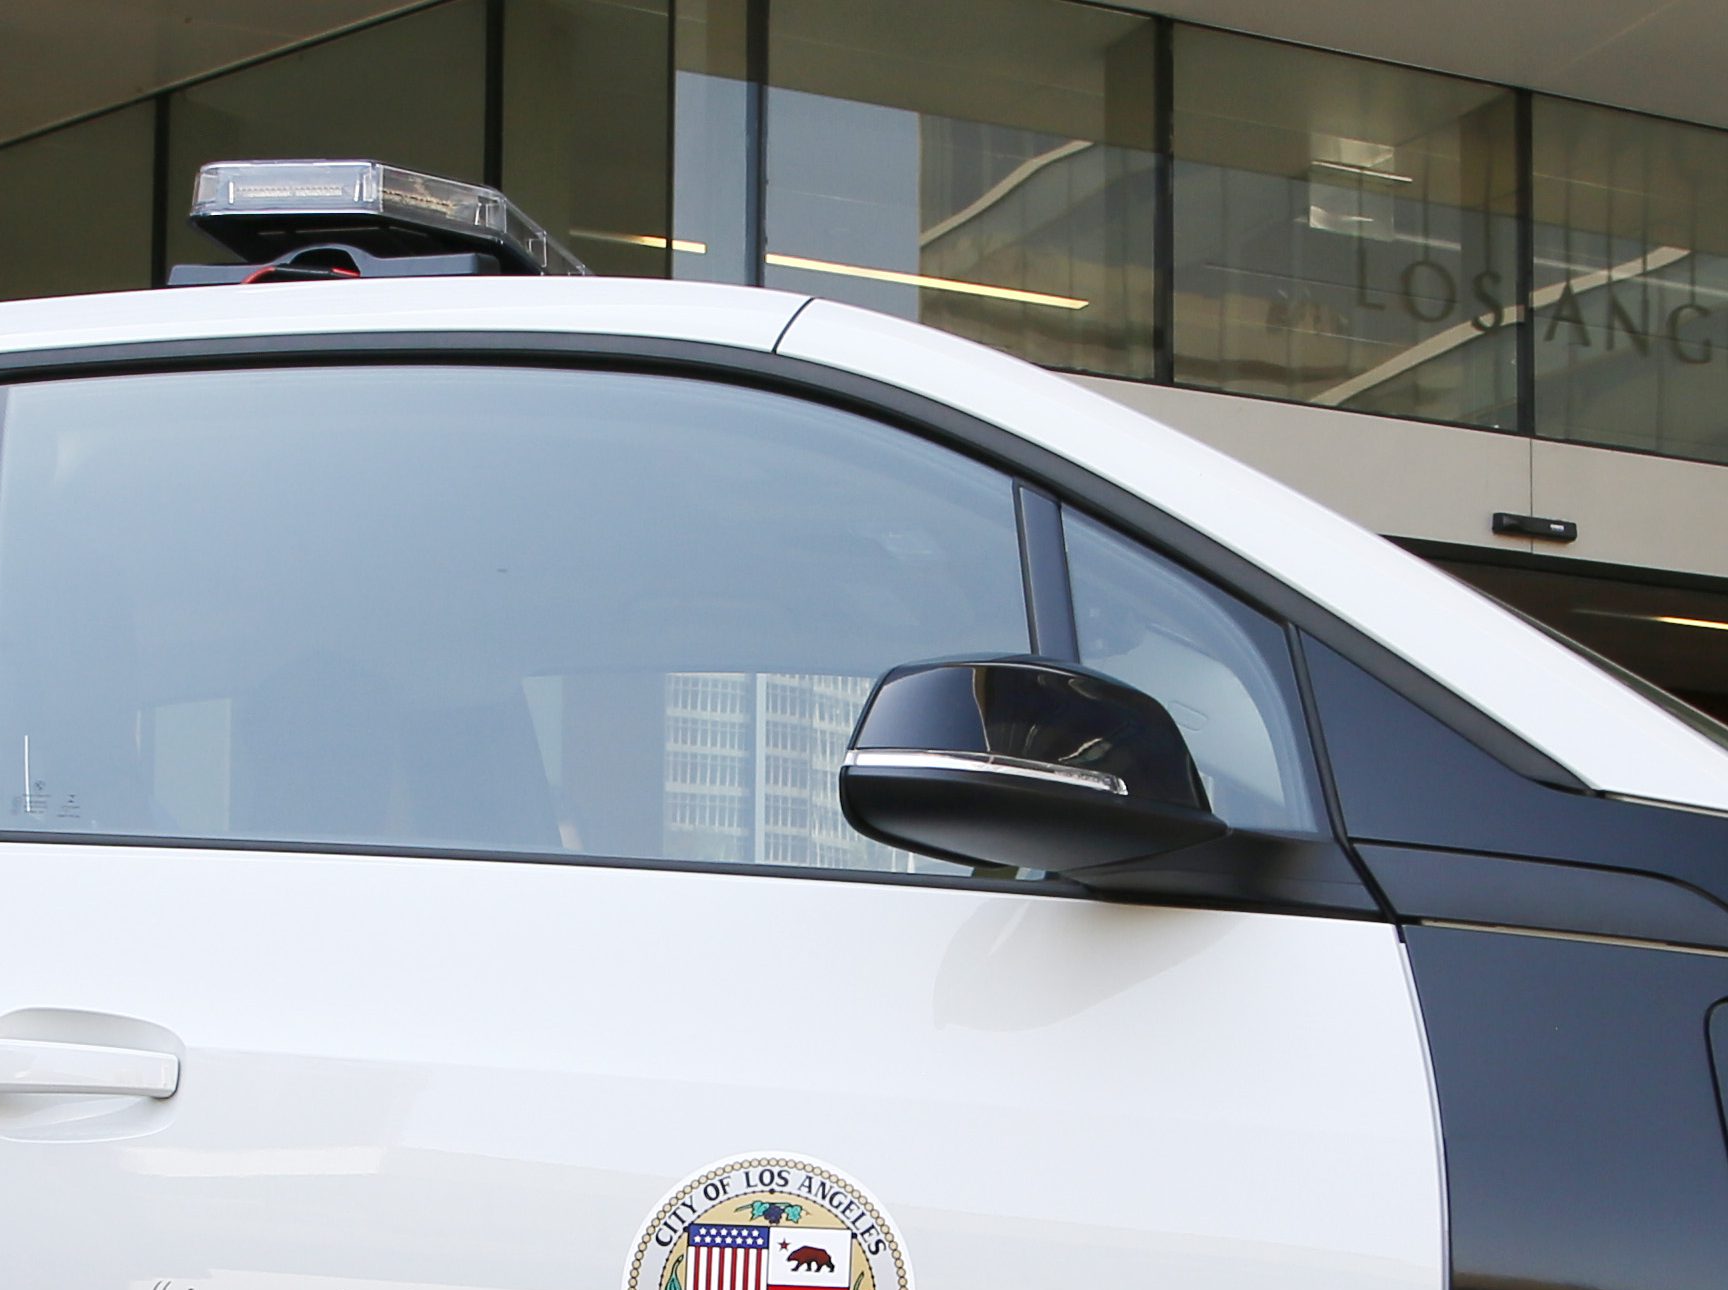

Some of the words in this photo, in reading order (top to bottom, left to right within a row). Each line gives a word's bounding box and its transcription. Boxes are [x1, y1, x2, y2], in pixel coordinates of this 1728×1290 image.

[1356, 250, 1506, 336] LOS
[654, 1194, 699, 1248] CITY
[702, 1175, 733, 1203] OF
[744, 1168, 791, 1188] LOS
[796, 1175, 888, 1257] ANGELES
